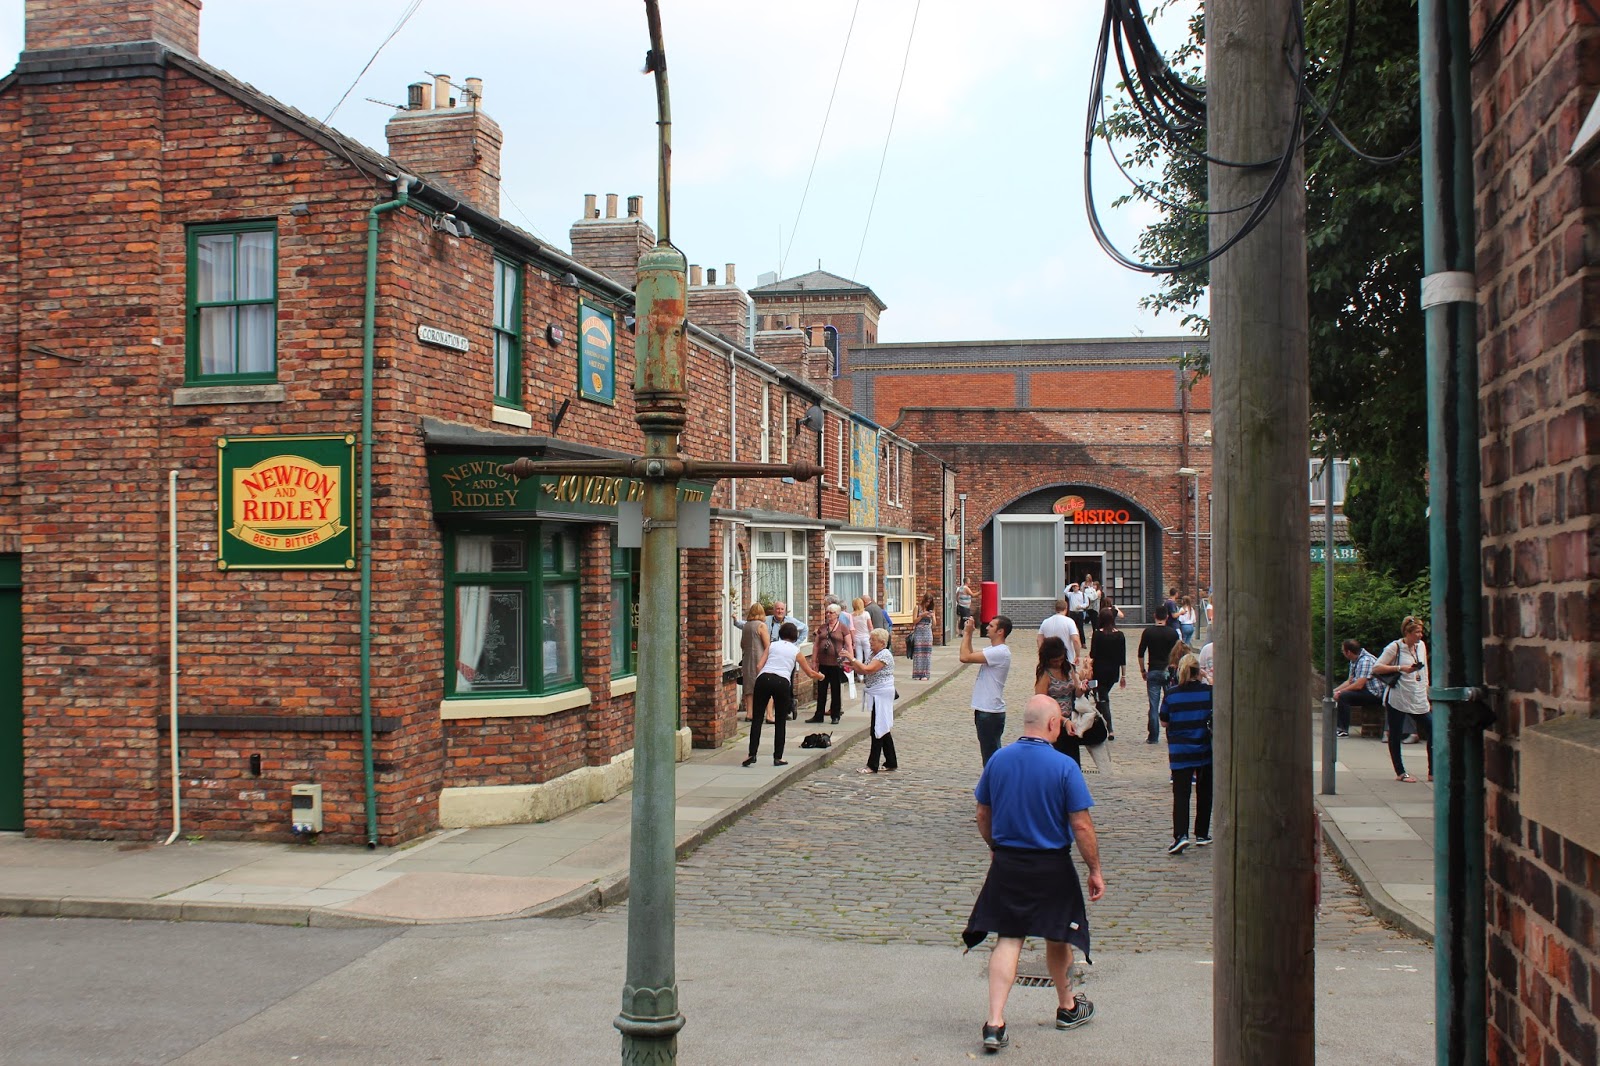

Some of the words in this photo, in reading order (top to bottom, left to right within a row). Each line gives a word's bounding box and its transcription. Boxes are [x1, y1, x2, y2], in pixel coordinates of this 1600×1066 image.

[422, 328, 460, 347] CORONATION
[241, 465, 337, 499] NEWTON
[472, 479, 497, 489] AND
[273, 487, 297, 498] AND
[450, 489, 519, 507] RIDLEY
[242, 498, 332, 521] RIDLEY
[1073, 509, 1130, 524] BISTRO
[252, 533, 279, 547] BEST
[285, 532, 320, 548] BITTER
